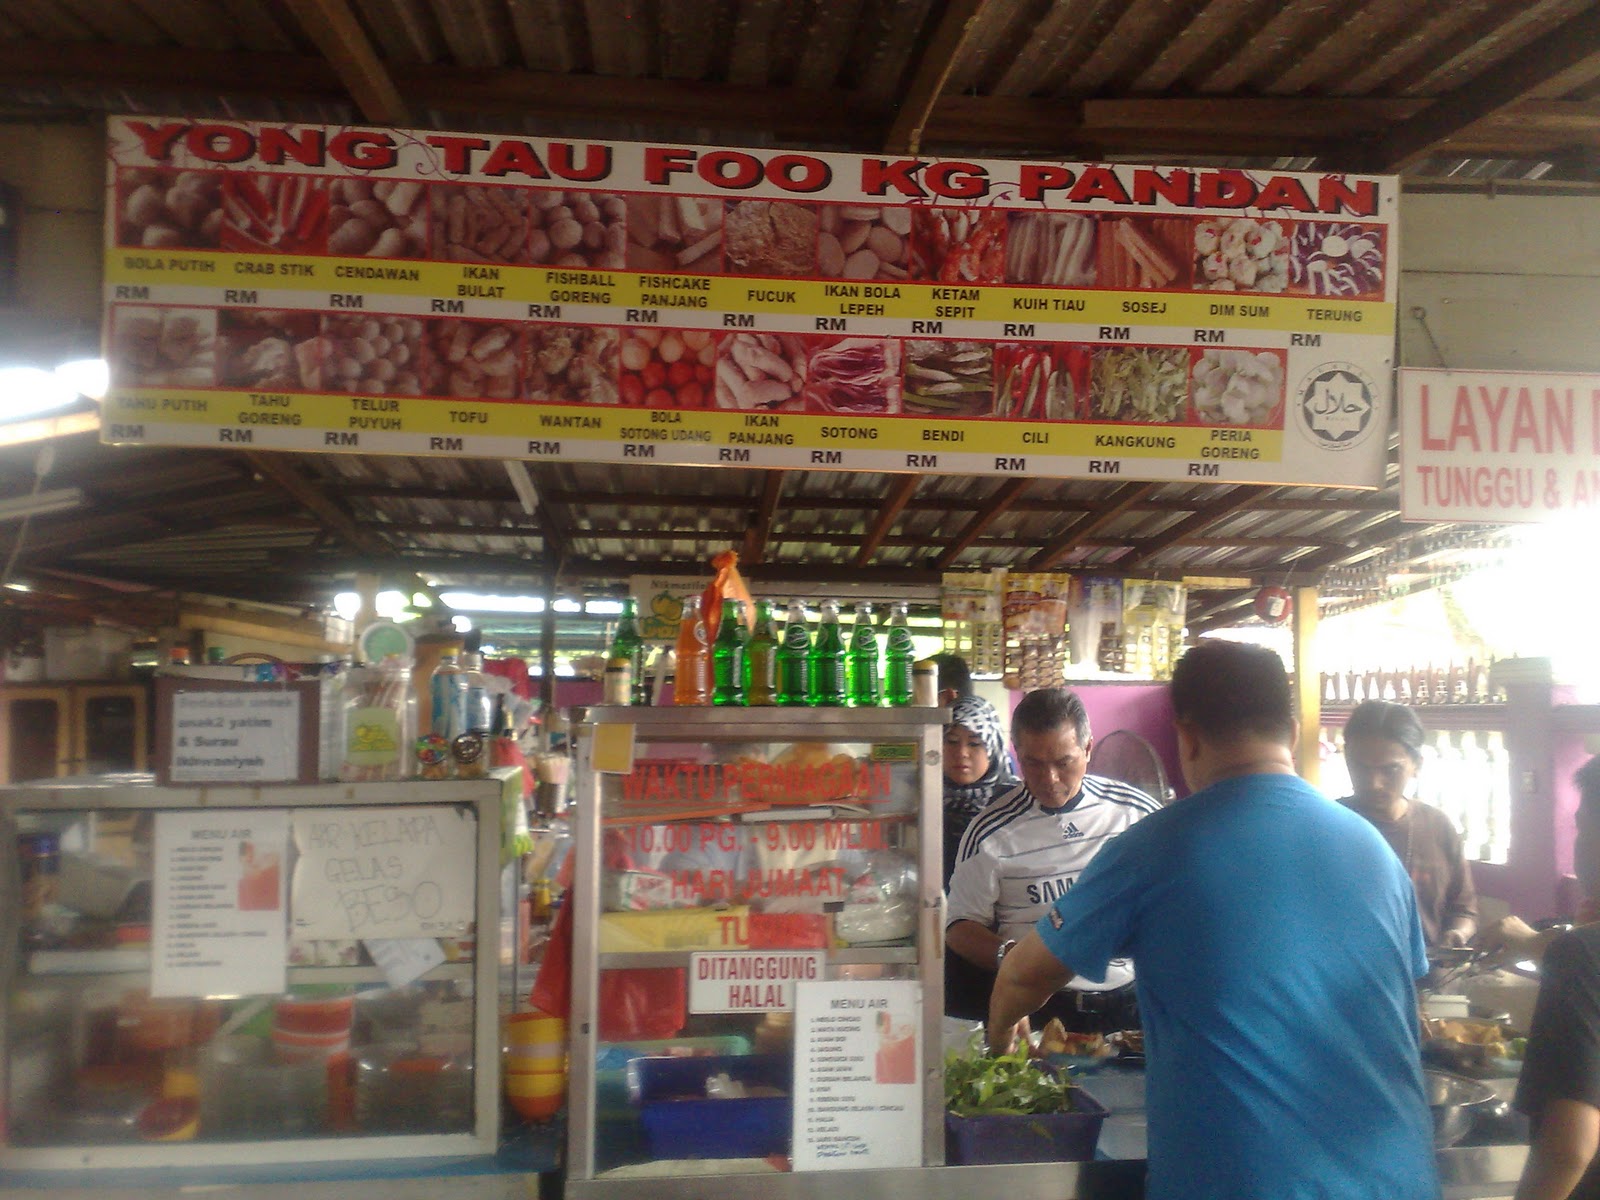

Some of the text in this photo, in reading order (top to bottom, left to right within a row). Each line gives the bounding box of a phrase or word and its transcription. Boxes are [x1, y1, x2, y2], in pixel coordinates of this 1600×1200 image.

[123, 119, 1379, 216] YONG TAU FOO KG PANDAN
[124, 257, 216, 273] BOLA PUTIH
[234, 261, 315, 277] CRAB STIK
[334, 265, 419, 281] CENDAWAN
[463, 267, 499, 280] IKAN
[546, 272, 616, 287] FISHBALL
[639, 276, 711, 290] FISHCAKE
[115, 285, 149, 299] RM
[224, 289, 258, 303] RM
[457, 284, 504, 298] BULAT
[550, 290, 612, 304] GORENG
[747, 289, 796, 303] FUCUK
[825, 285, 901, 299] IKAN BOLA
[932, 287, 980, 301] KETAM
[330, 294, 364, 308] RM
[431, 299, 464, 313] RM
[641, 294, 707, 308] PANJANG
[1013, 298, 1086, 312] KUIH TIAU
[1122, 301, 1167, 314] SOSEJ
[528, 304, 561, 318] RM
[626, 309, 658, 323] RM
[840, 303, 885, 316] LEPEH
[935, 306, 975, 318] SEPIT
[1210, 304, 1270, 317] DIM SUM
[1307, 308, 1362, 322] TERUNG
[723, 313, 755, 327] RM
[815, 317, 847, 331] RM
[911, 321, 943, 334] RM
[1003, 324, 1035, 337] RM
[1099, 327, 1131, 340] RM
[1194, 329, 1225, 343] RM
[1291, 333, 1321, 347] RM
[162, 399, 208, 412] PUTIH
[250, 394, 290, 408] TAHU
[352, 398, 399, 412] TELUR
[238, 413, 301, 426] GORENG
[349, 416, 401, 430] PUYUH
[450, 411, 488, 424] TOFU
[540, 414, 602, 428] WANTAN
[651, 412, 682, 424] BOLA
[744, 415, 779, 427] IKAN
[1421, 385, 1574, 453] LAYAN
[110, 424, 144, 438] RM
[219, 428, 253, 443] RM
[620, 427, 711, 441] SOTONG UDANG
[821, 427, 878, 440] SOTONG
[922, 429, 964, 442] BENDI
[1022, 431, 1049, 444] CILI
[1211, 430, 1252, 443] PERIA
[324, 432, 358, 446] RM
[430, 436, 463, 451] RM
[729, 432, 794, 445] PANJANG
[1095, 434, 1176, 449] KANGKUNG
[528, 440, 561, 455] RM
[623, 444, 655, 458] RM
[1201, 446, 1260, 459] GORENG
[719, 448, 750, 462] RM
[811, 451, 842, 464] RM
[906, 454, 937, 468] RM
[995, 457, 1026, 471] RM
[1089, 460, 1120, 474] RM
[1188, 463, 1219, 477] RM
[1417, 466, 1534, 508] TUNGGU
[1544, 468, 1560, 508] &
[622, 762, 891, 799] WAKTU PERNIAGAAN
[628, 823, 693, 853] 10.00
[766, 823, 816, 850] 9.00
[671, 868, 735, 899] HARI
[1026, 877, 1073, 904] SAM
[698, 956, 817, 981] DITANGGUNG
[729, 984, 785, 1008] HALAL
[830, 998, 889, 1009] MENU AIR
